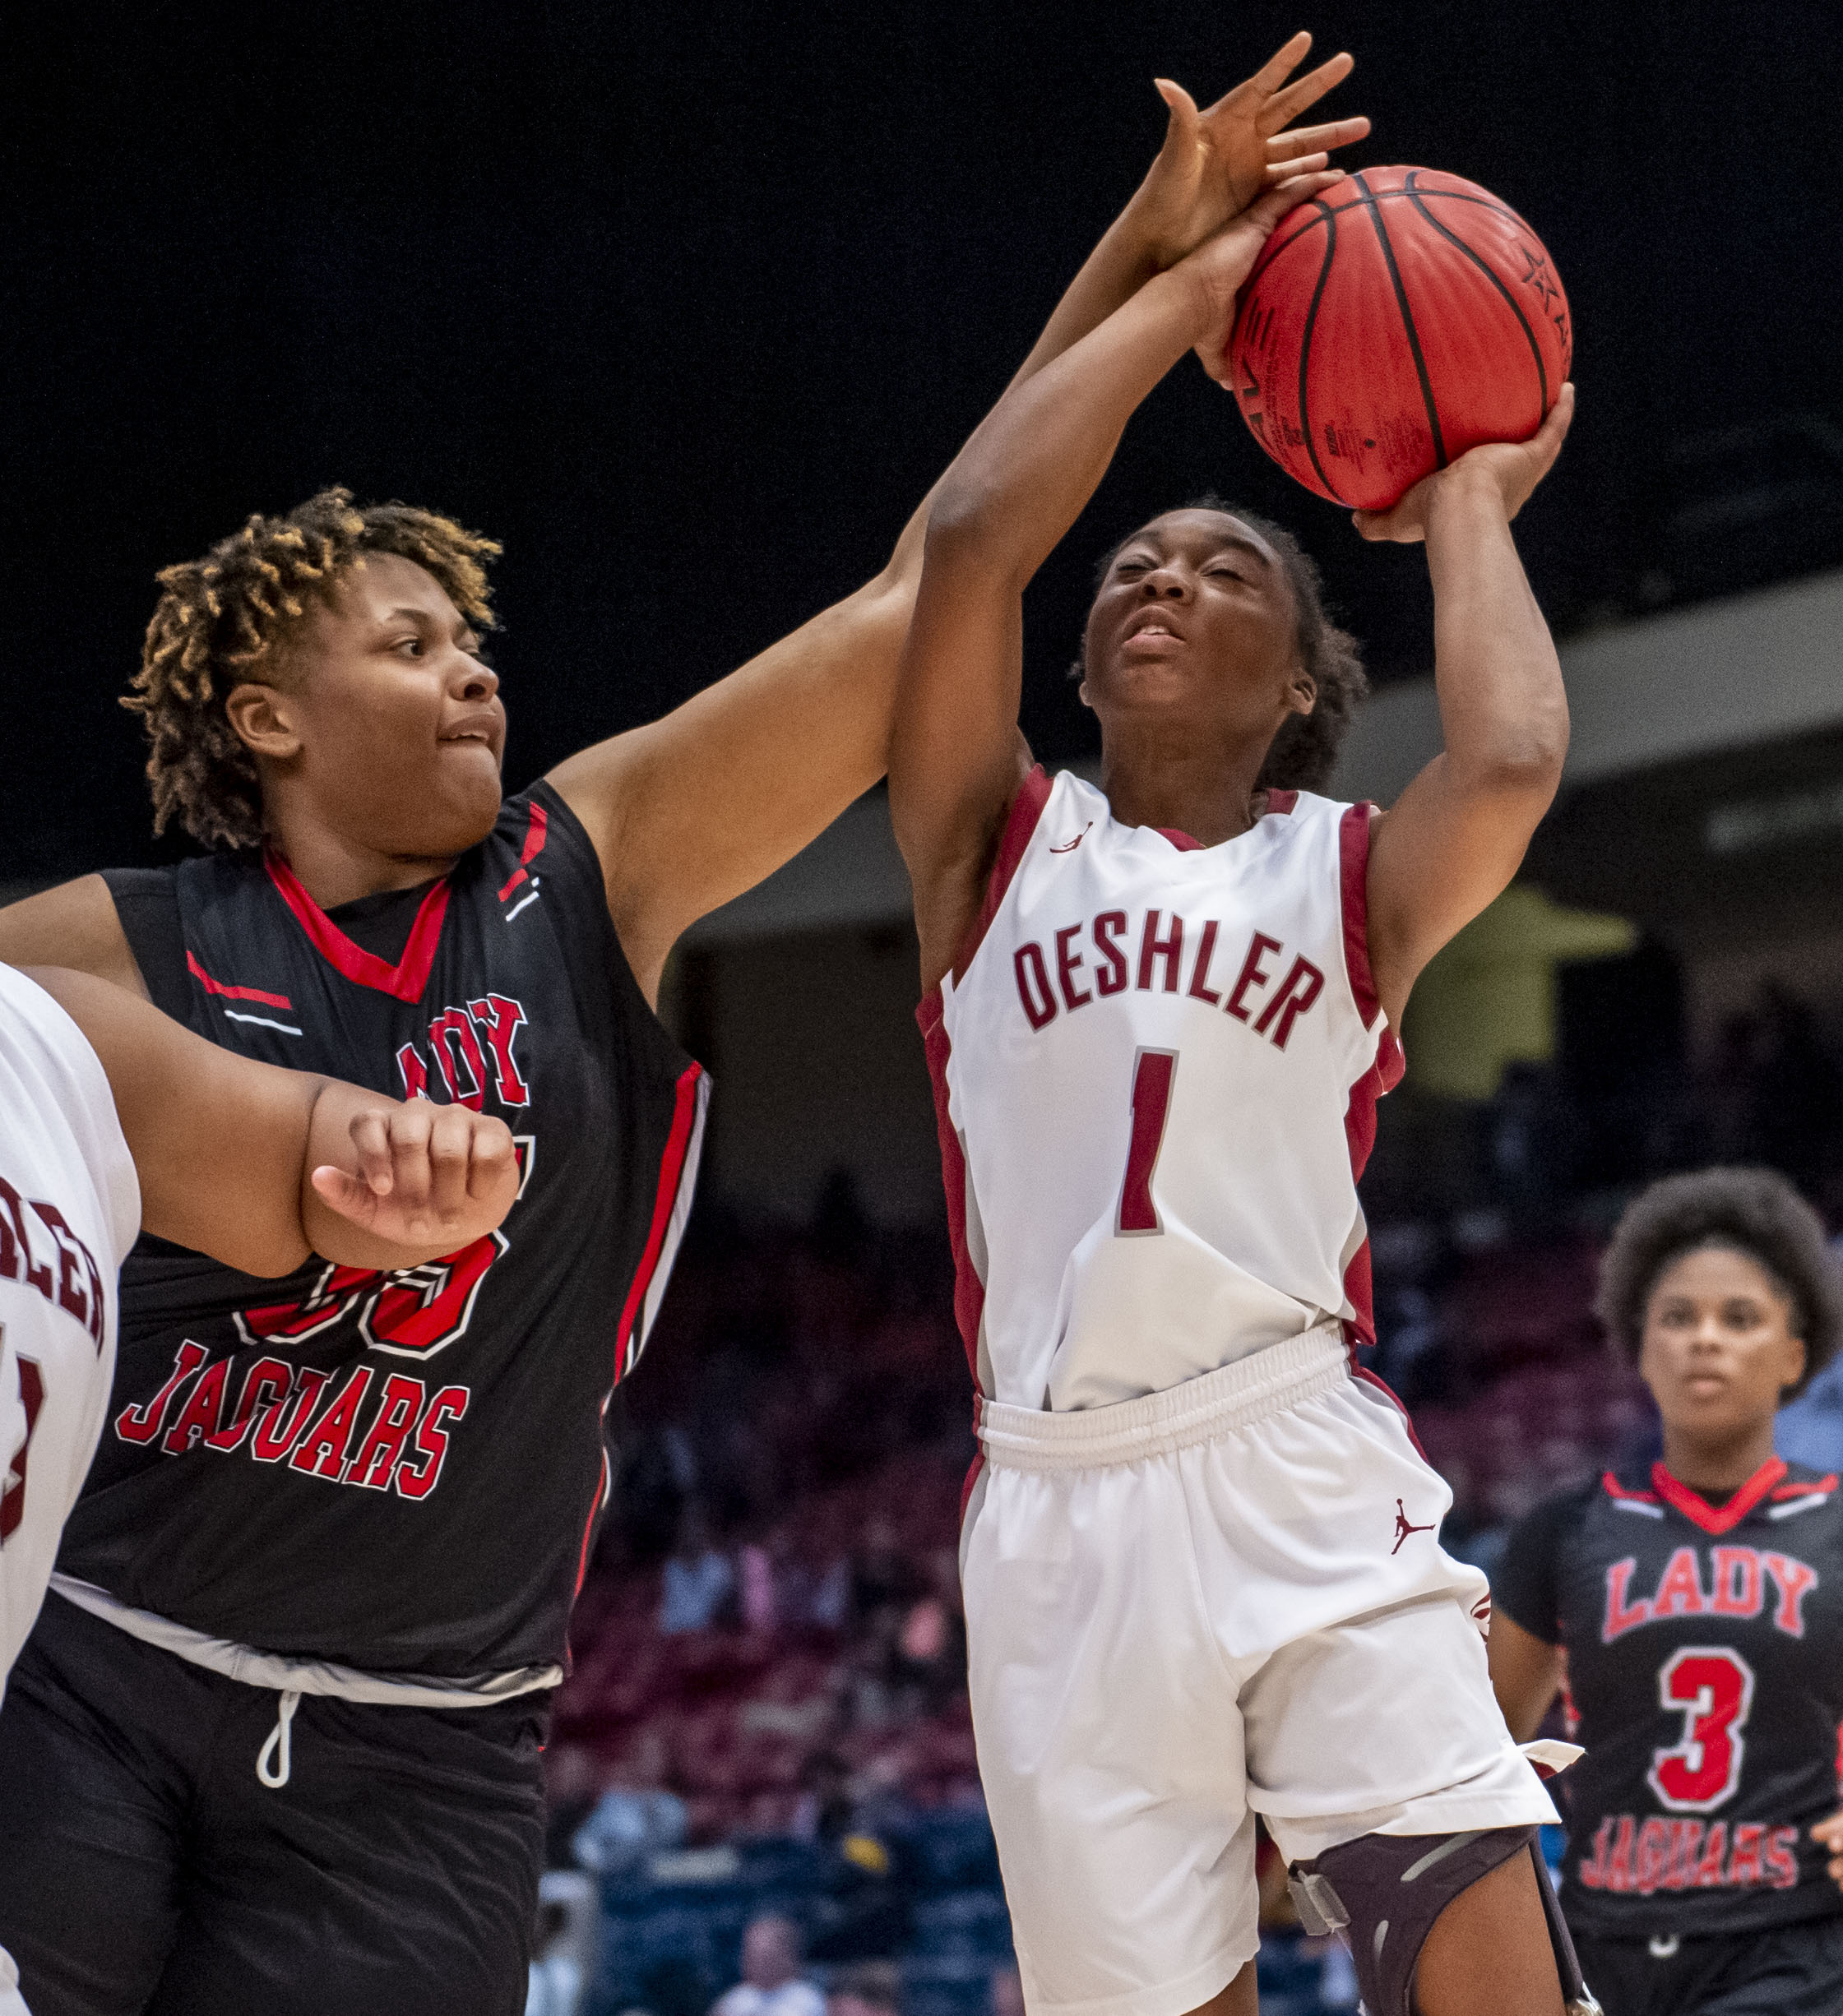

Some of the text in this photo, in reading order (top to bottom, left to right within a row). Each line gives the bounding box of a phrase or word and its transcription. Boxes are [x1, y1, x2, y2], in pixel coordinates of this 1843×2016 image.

[1013, 908, 1326, 1052] DESHLER
[396, 992, 530, 1113] ADY
[1114, 1045, 1180, 1238] 1
[114, 1339, 470, 1500] JAGUARS
[1603, 1546, 1818, 1643] LADY
[1647, 1646, 1754, 1811] 3
[1579, 1815, 1799, 1894] JAGUARS
